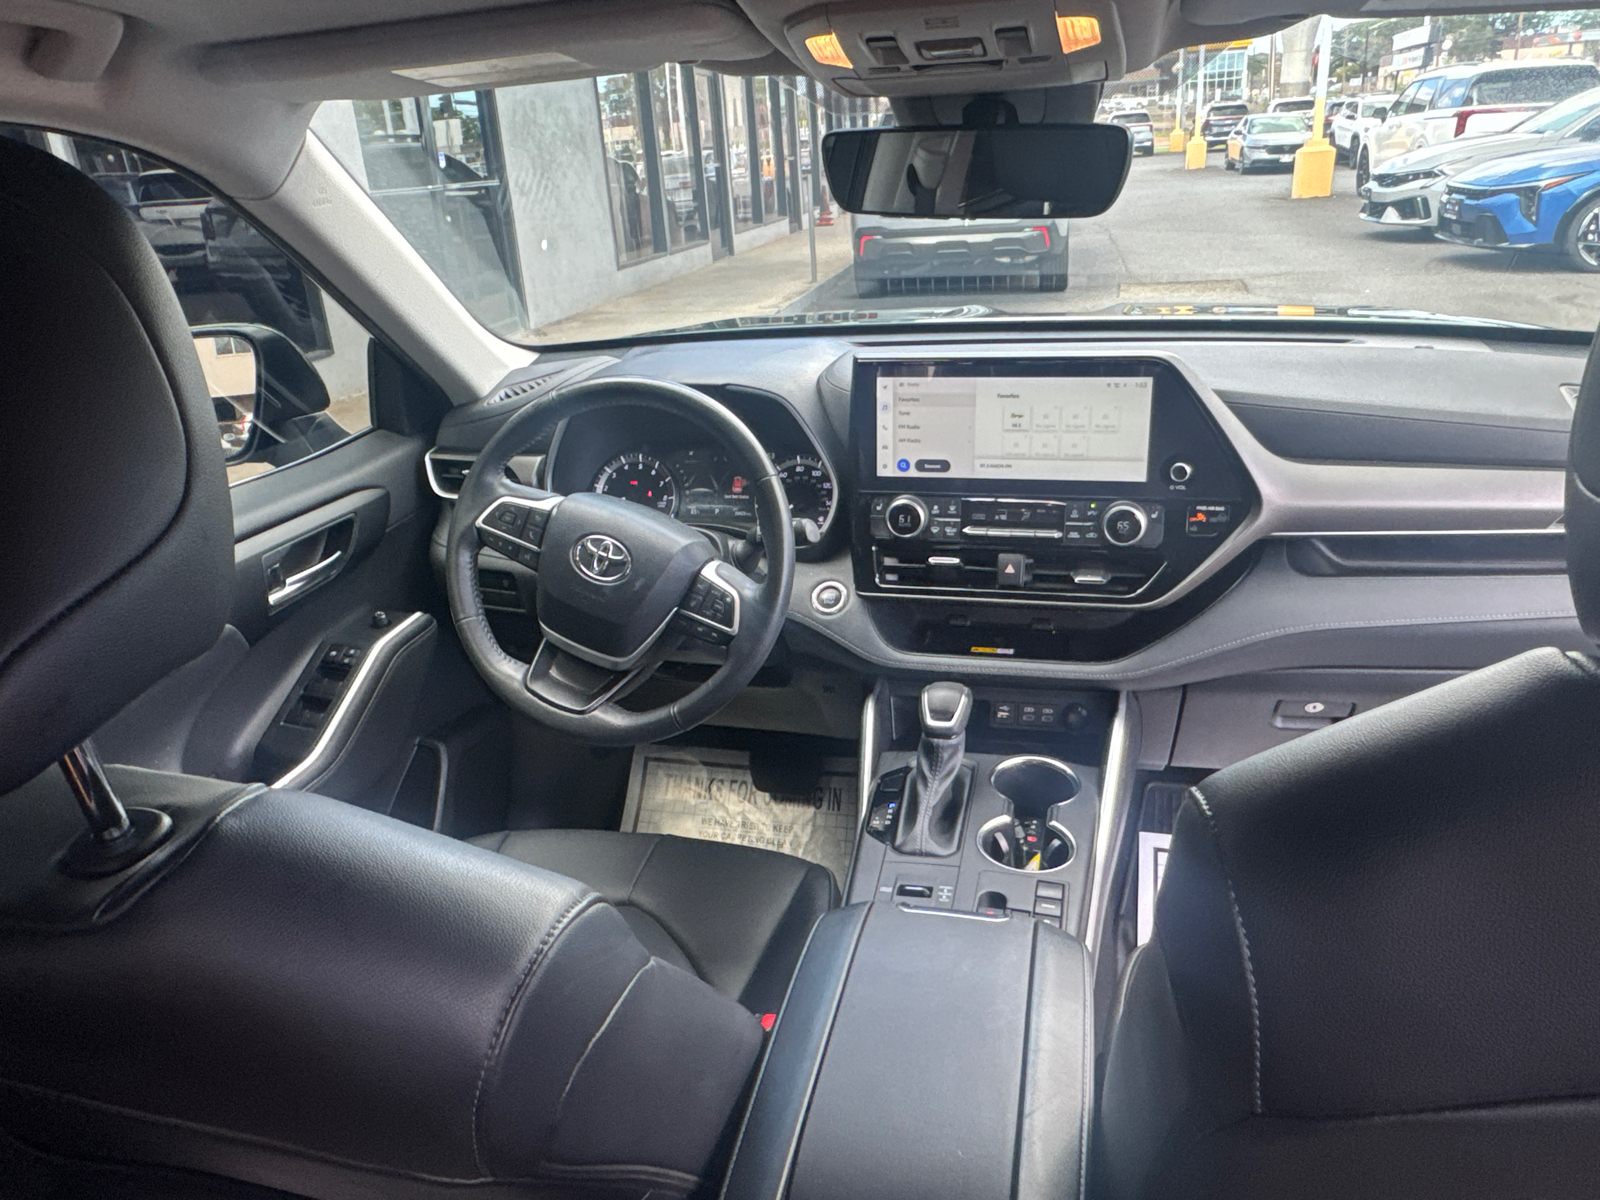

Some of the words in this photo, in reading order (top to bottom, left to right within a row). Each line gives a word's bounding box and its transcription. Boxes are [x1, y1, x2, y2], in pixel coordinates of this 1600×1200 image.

[1117, 521, 1130, 530] 65
[665, 773, 724, 803] THANKS
[728, 779, 759, 806] FOR
[827, 786, 842, 812] IN
[701, 817, 713, 826] WE
[714, 818, 734, 828] HAVE
[772, 824, 794, 834] KEEP
[698, 830, 718, 839] YOUR
